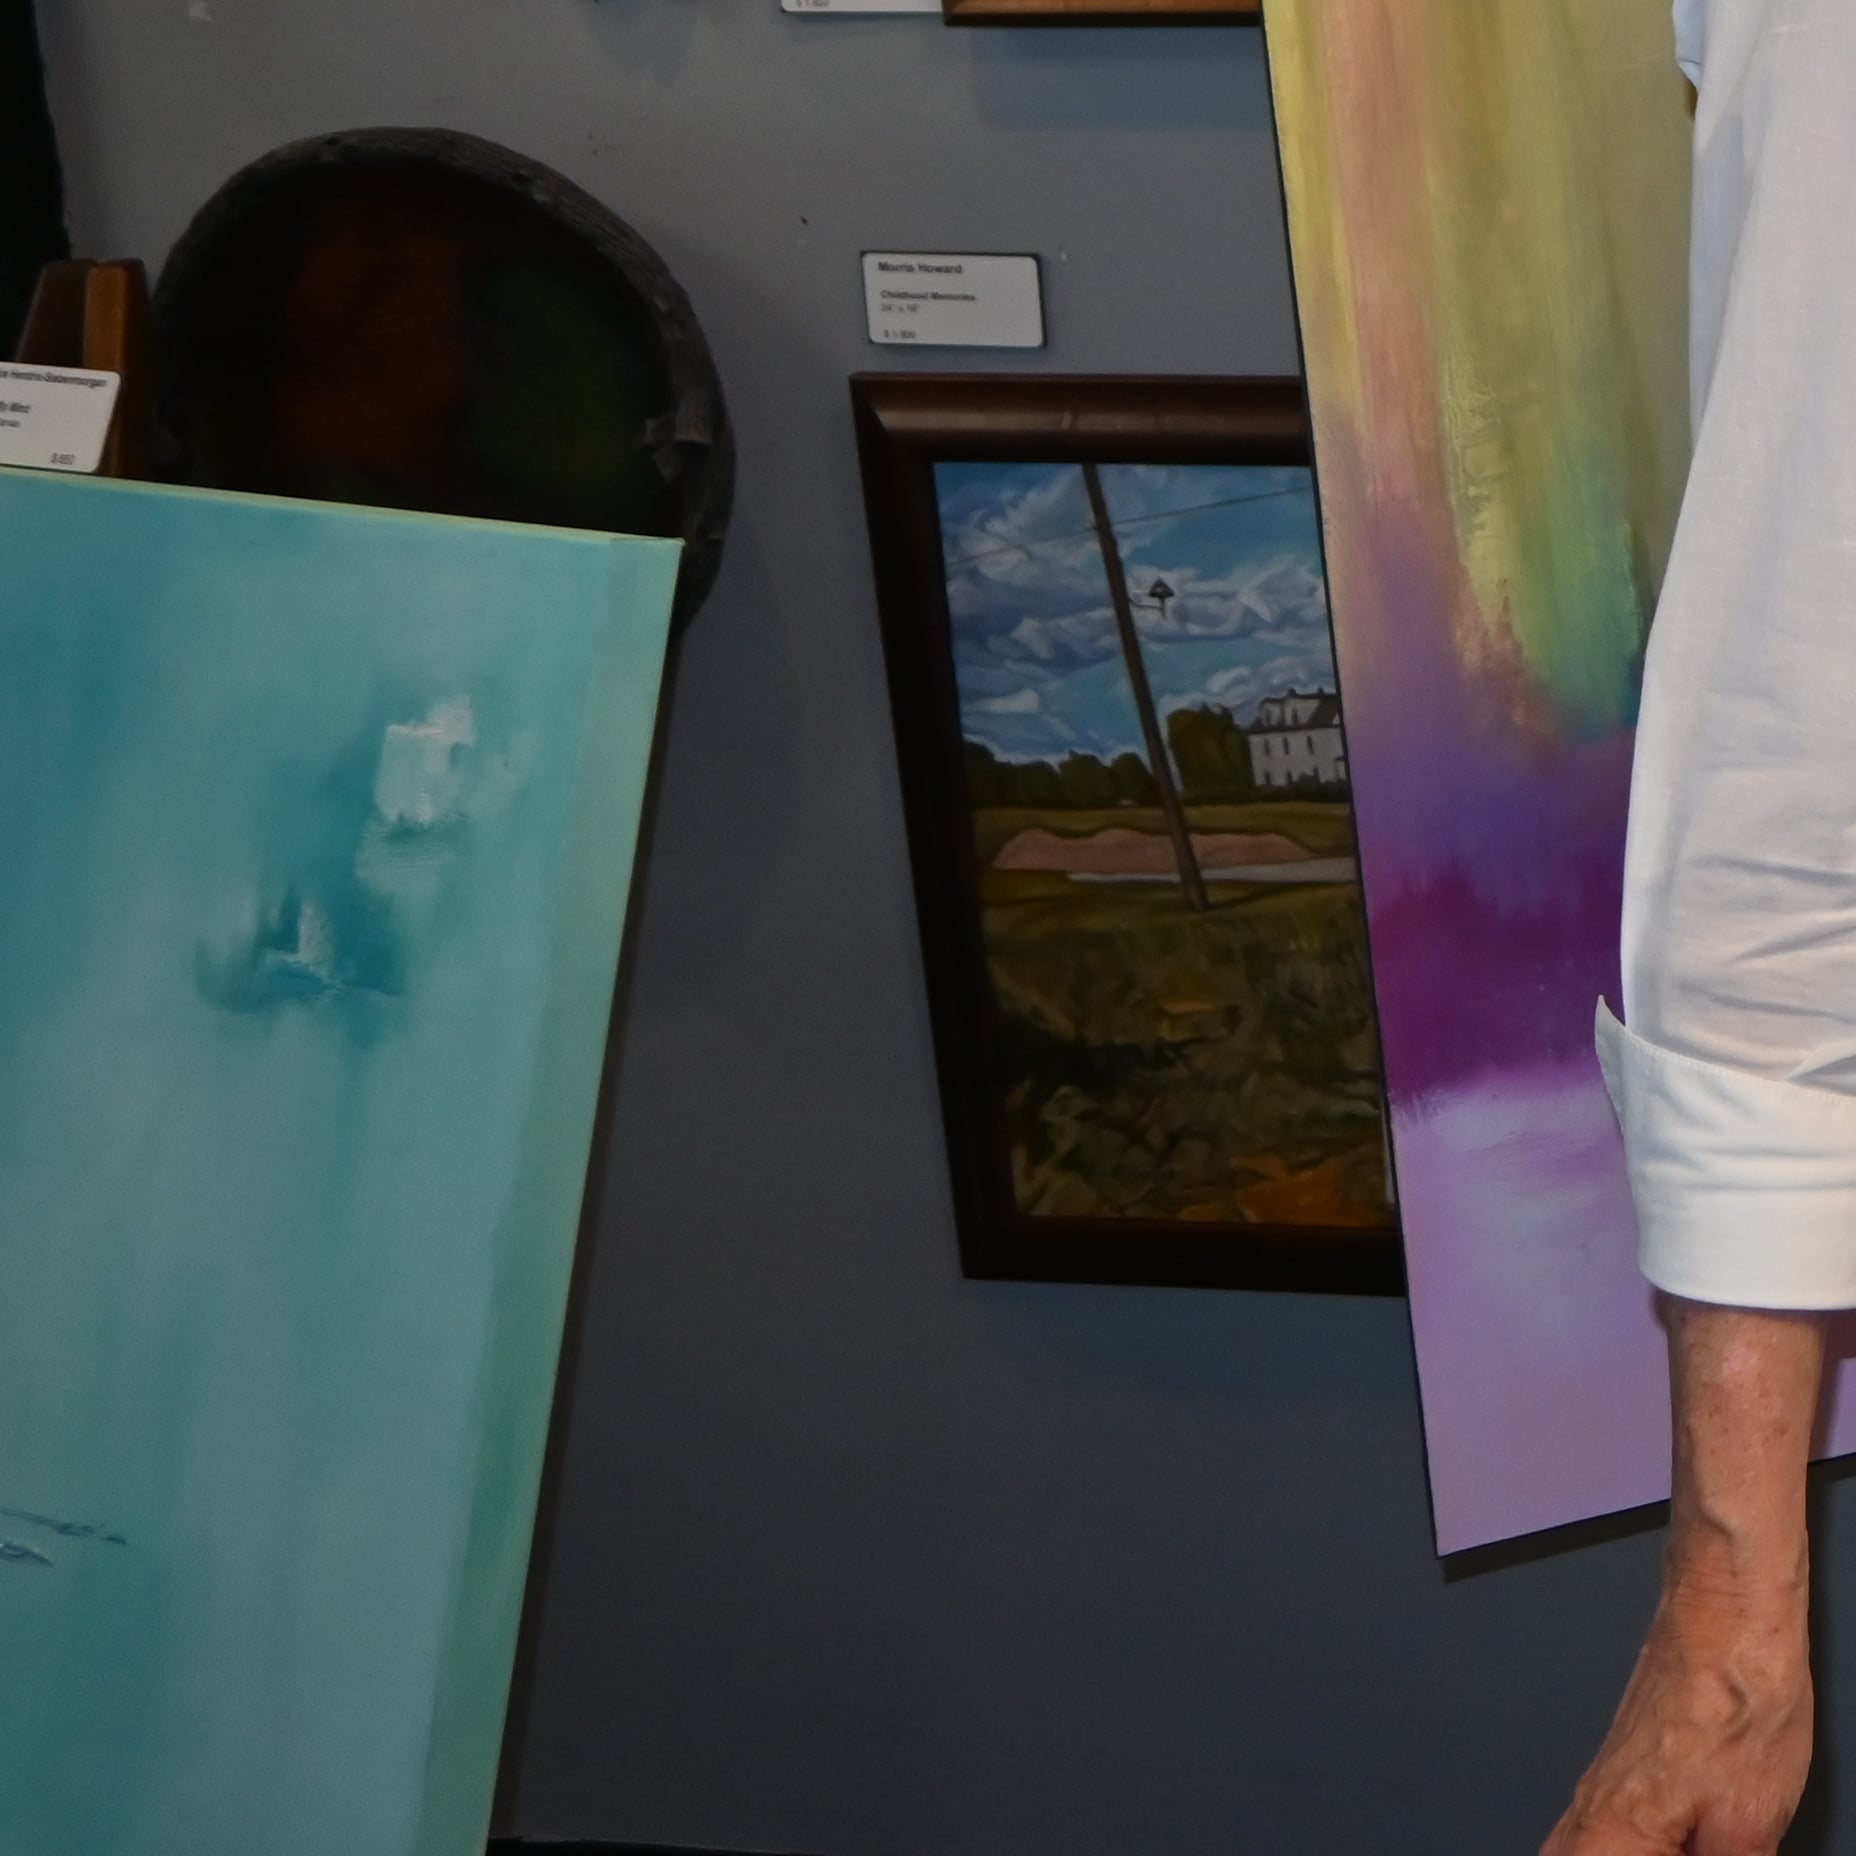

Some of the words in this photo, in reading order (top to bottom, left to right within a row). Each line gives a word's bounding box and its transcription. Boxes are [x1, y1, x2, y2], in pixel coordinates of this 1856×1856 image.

[878, 261, 915, 273] Morris
[917, 263, 963, 274] Howard
[880, 290, 928, 301] Childhood
[930, 291, 977, 302] Memories
